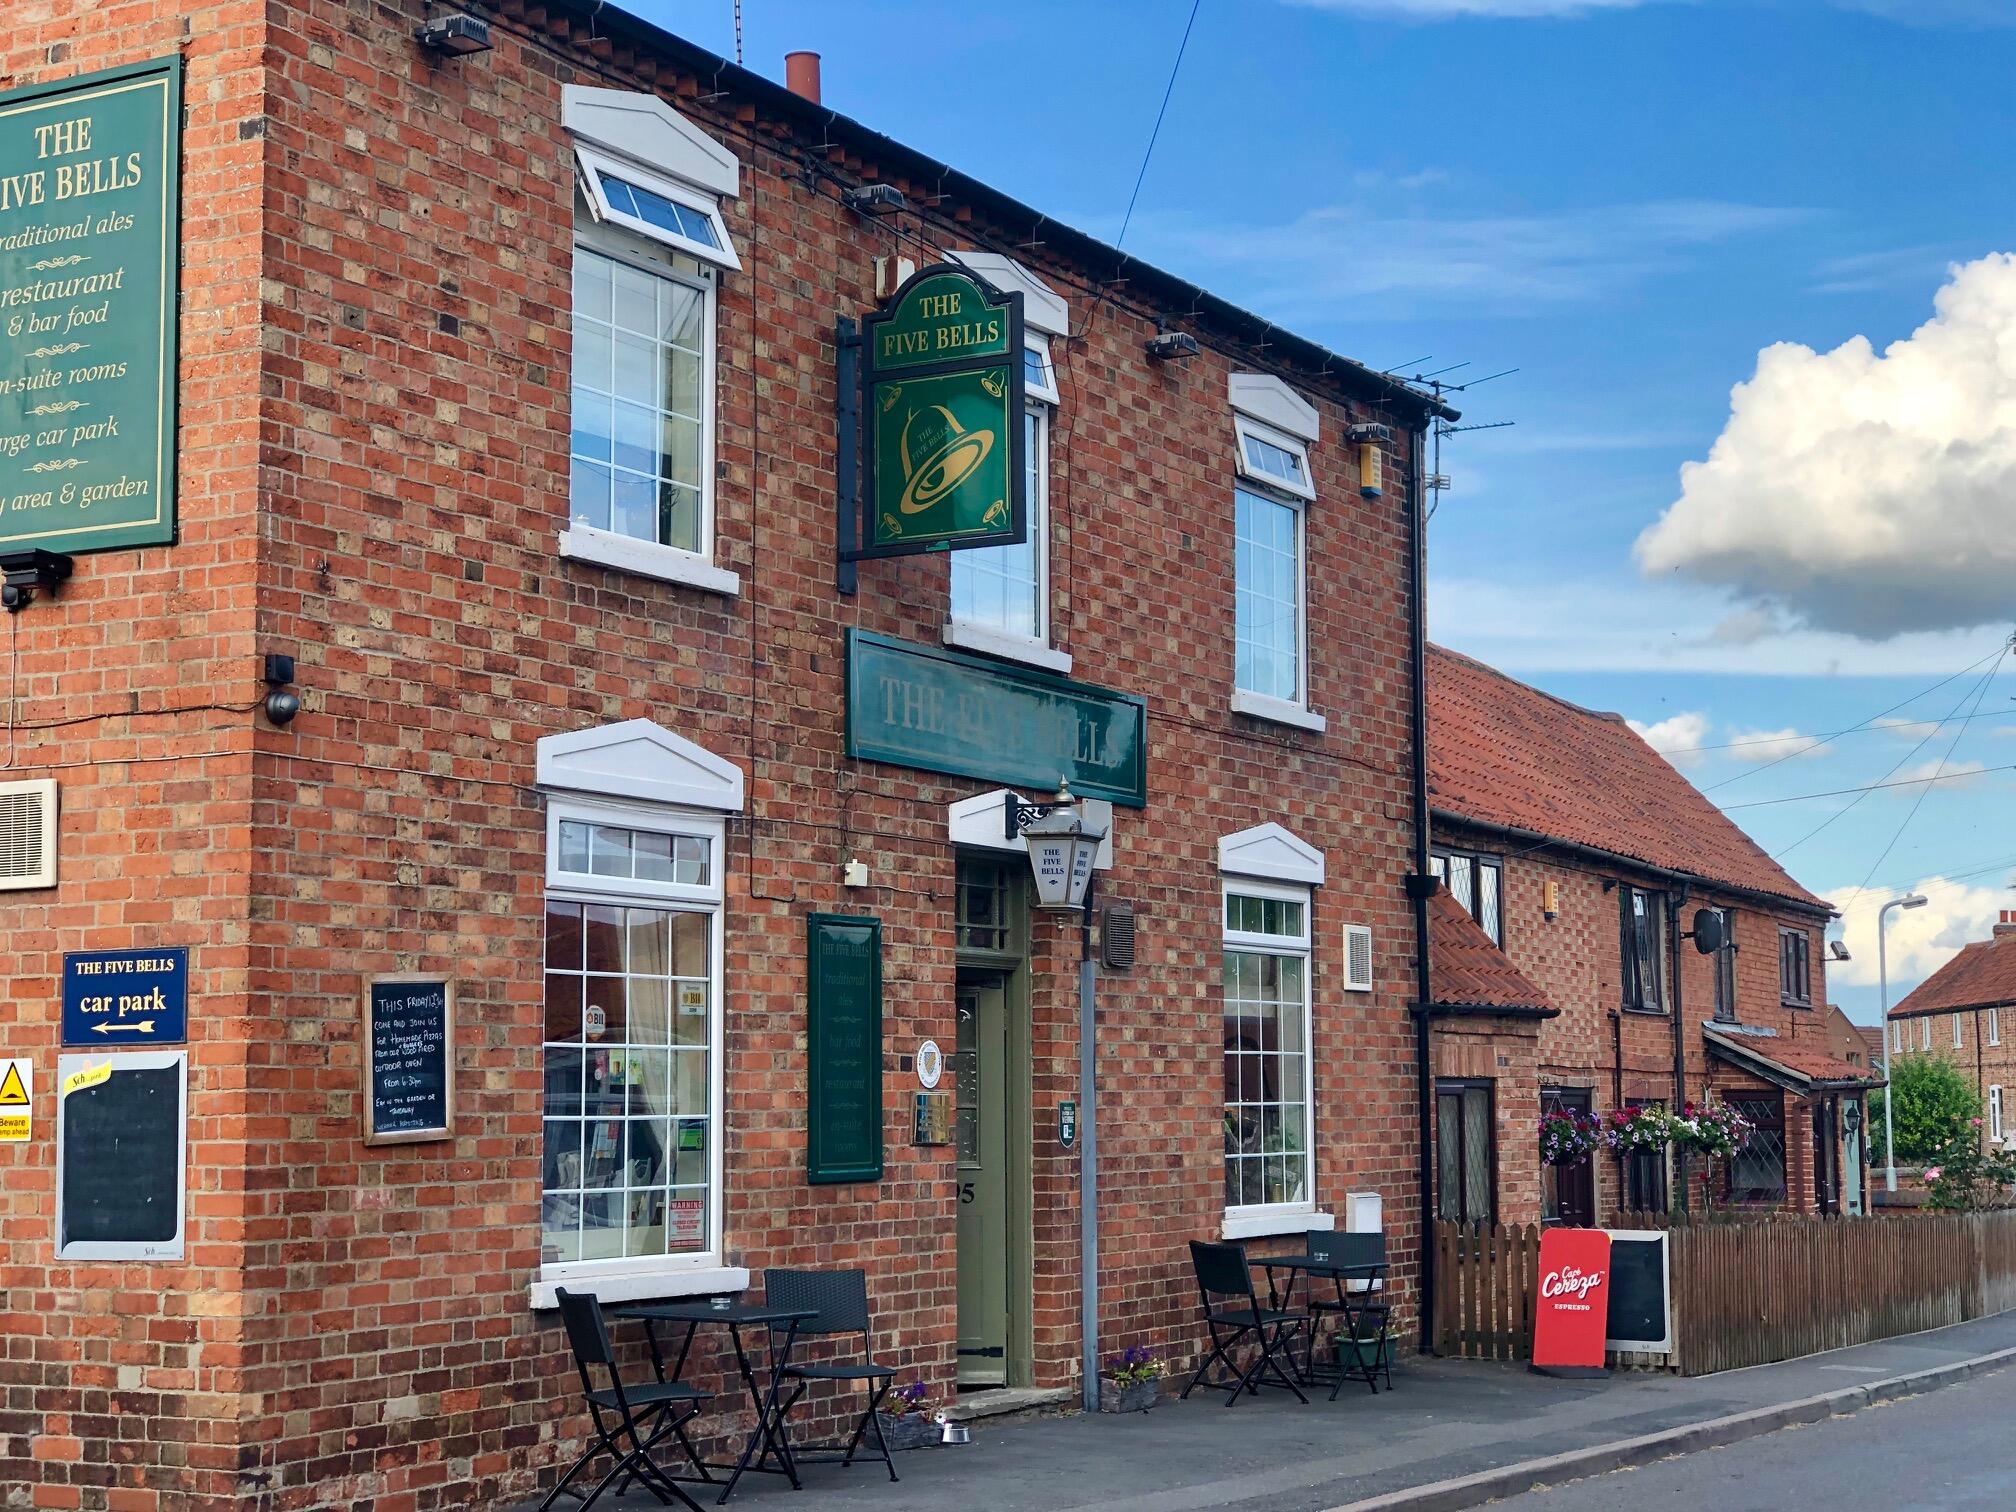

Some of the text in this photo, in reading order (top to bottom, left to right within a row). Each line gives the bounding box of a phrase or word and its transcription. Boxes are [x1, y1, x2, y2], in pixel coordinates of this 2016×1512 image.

[34, 117, 92, 159] THE
[55, 152, 142, 201] BELLS
[96, 210, 135, 236] ales
[0, 266, 125, 308] restaurant
[919, 292, 961, 319] THE
[7, 300, 109, 337] & bar food
[884, 320, 999, 357] FIVE BELLS
[68, 361, 128, 385] rooms
[36, 428, 68, 447] car
[72, 415, 120, 448] park
[12, 490, 53, 511] area
[59, 482, 76, 504] &
[80, 475, 148, 509] garden
[879, 675, 945, 735] THE
[1043, 848, 1060, 856] THE
[1043, 858, 1061, 866] FIVE
[1079, 850, 1088, 858] THE
[1041, 867, 1065, 875] BELLS
[1073, 869, 1086, 877] BELLS
[1076, 860, 1086, 868] FIVE
[76, 958, 174, 975] THE FIVE BELLS
[80, 986, 166, 1017] car park
[378, 998, 403, 1013] THIS
[407, 994, 428, 1009] FRIDAY
[374, 1016, 437, 1031] COME AND JOIN US
[390, 1032, 422, 1045] HOMEMADE
[423, 1029, 443, 1041] PIZZAS
[374, 1057, 423, 1073] OUTDOOR OVEN
[956, 1182, 975, 1204] 5
[671, 1201, 703, 1209] WARNING
[1542, 1271, 1603, 1300] Cereza
[1553, 1303, 1591, 1311] ESPRESSO
